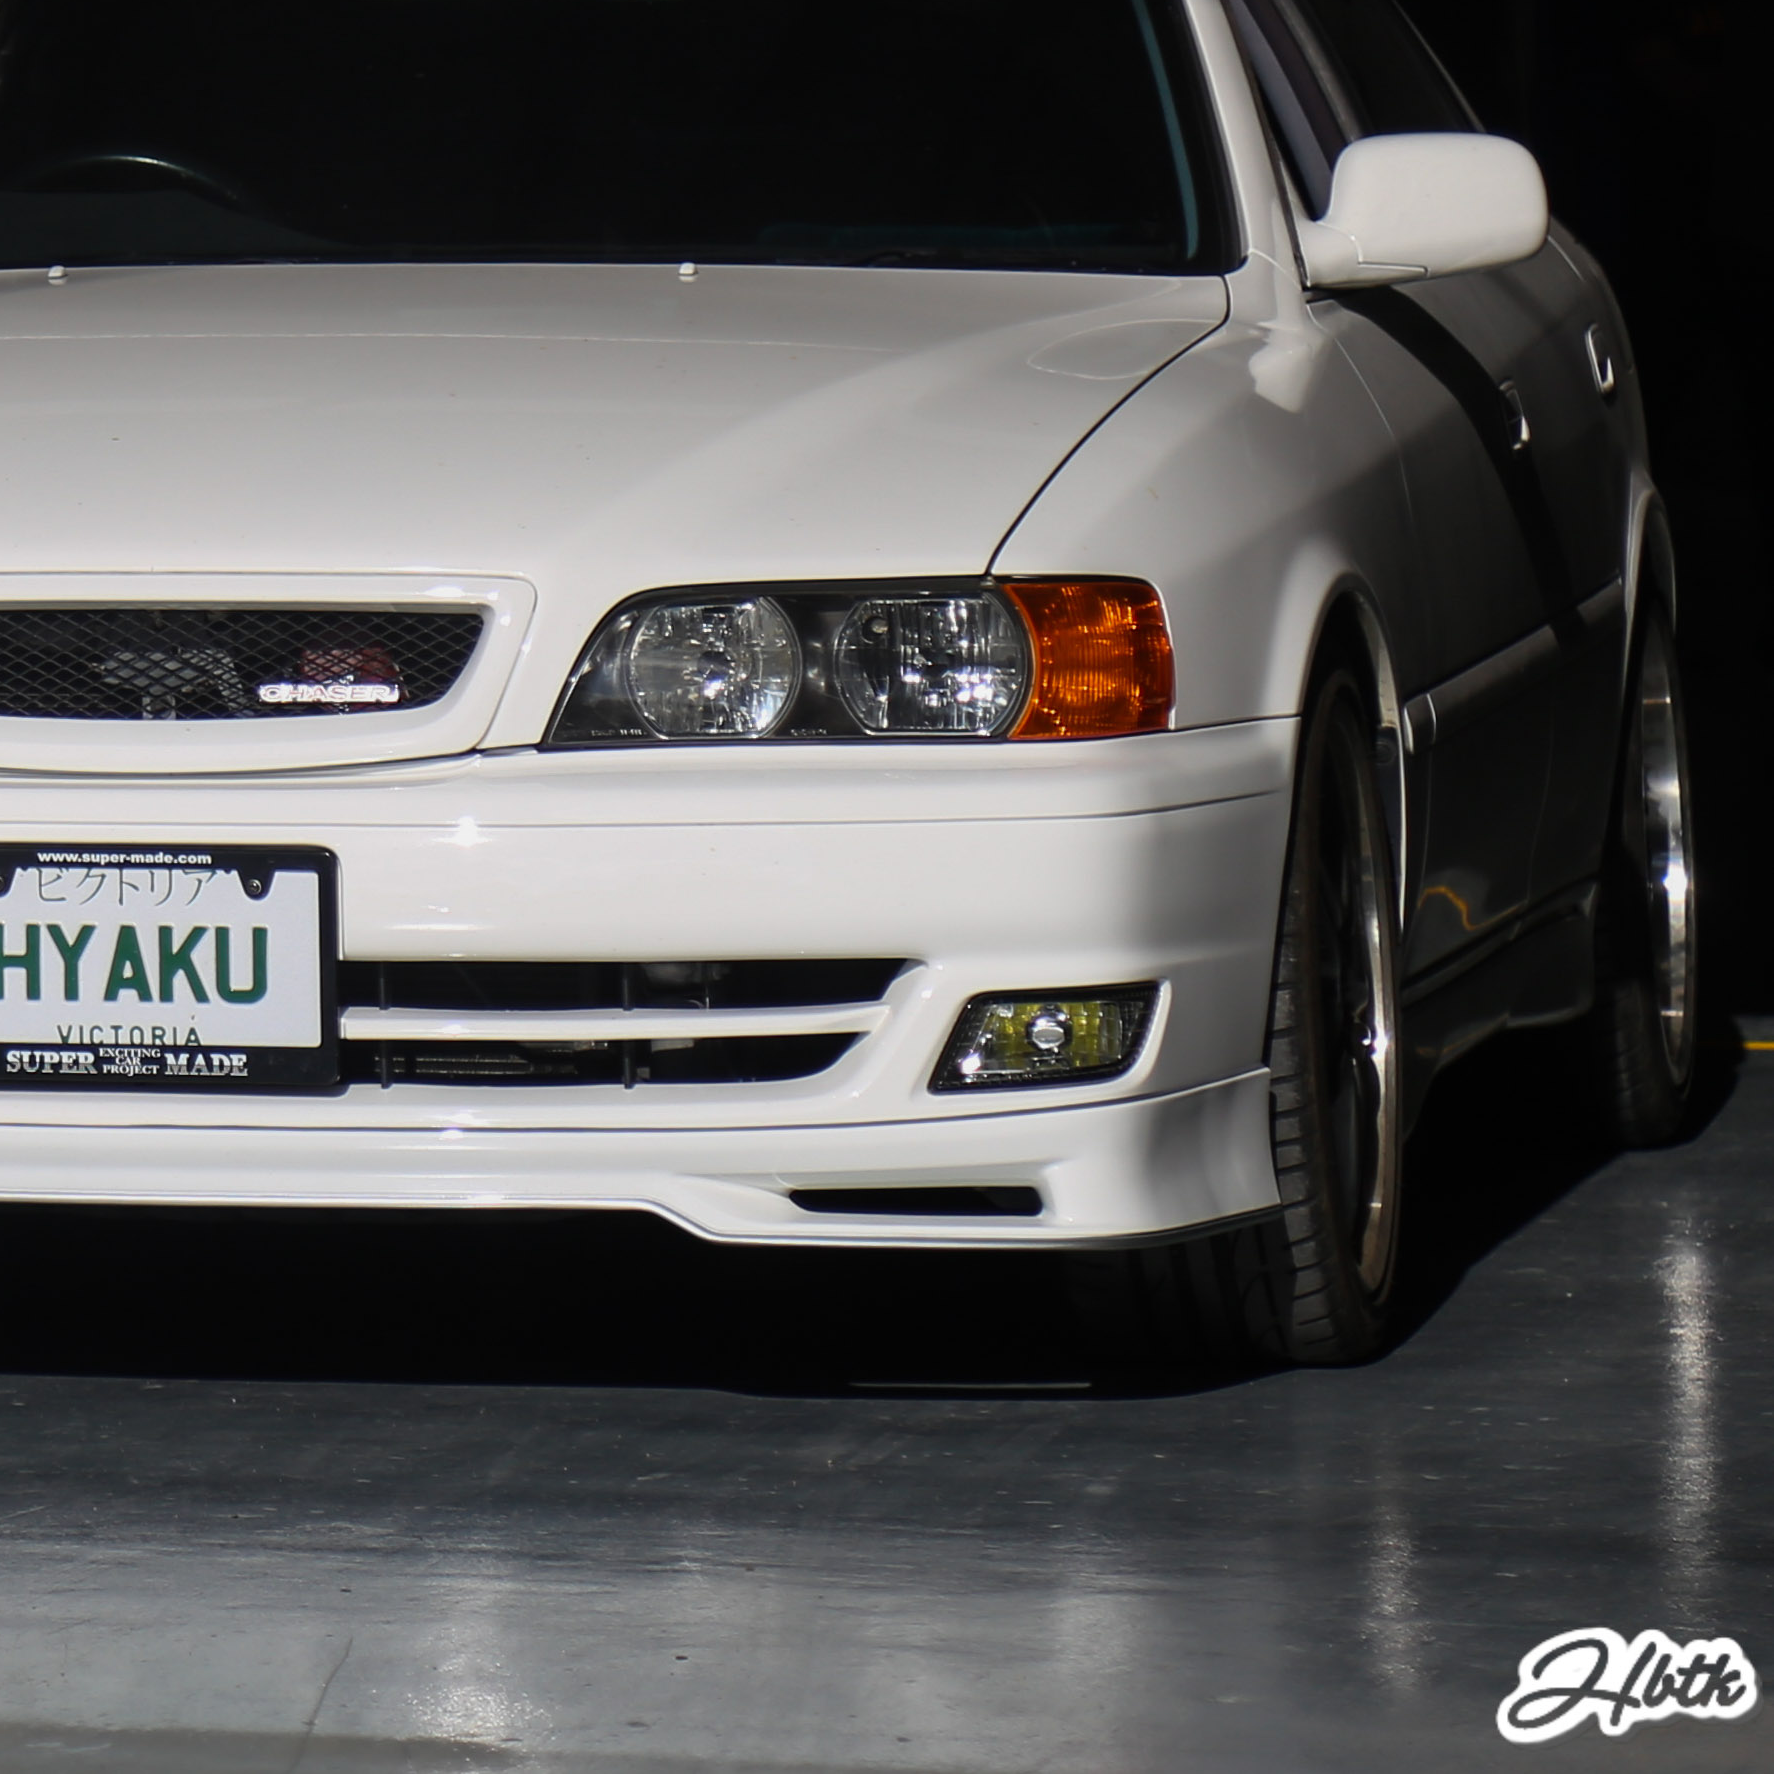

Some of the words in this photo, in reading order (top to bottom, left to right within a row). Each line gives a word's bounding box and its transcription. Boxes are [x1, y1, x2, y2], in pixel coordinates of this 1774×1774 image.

[259, 683, 399, 704] CHASER
[37, 851, 212, 866] www.super-made.com
[37, 868, 218, 906] ビクトリア
[56, 1025, 202, 1046] VICTORIA
[98, 1047, 162, 1058] EXCITING
[115, 1056, 142, 1066] CAR
[5, 1049, 98, 1074] SUPER
[164, 1052, 248, 1077] MADE
[102, 1064, 160, 1076] PROJECT
